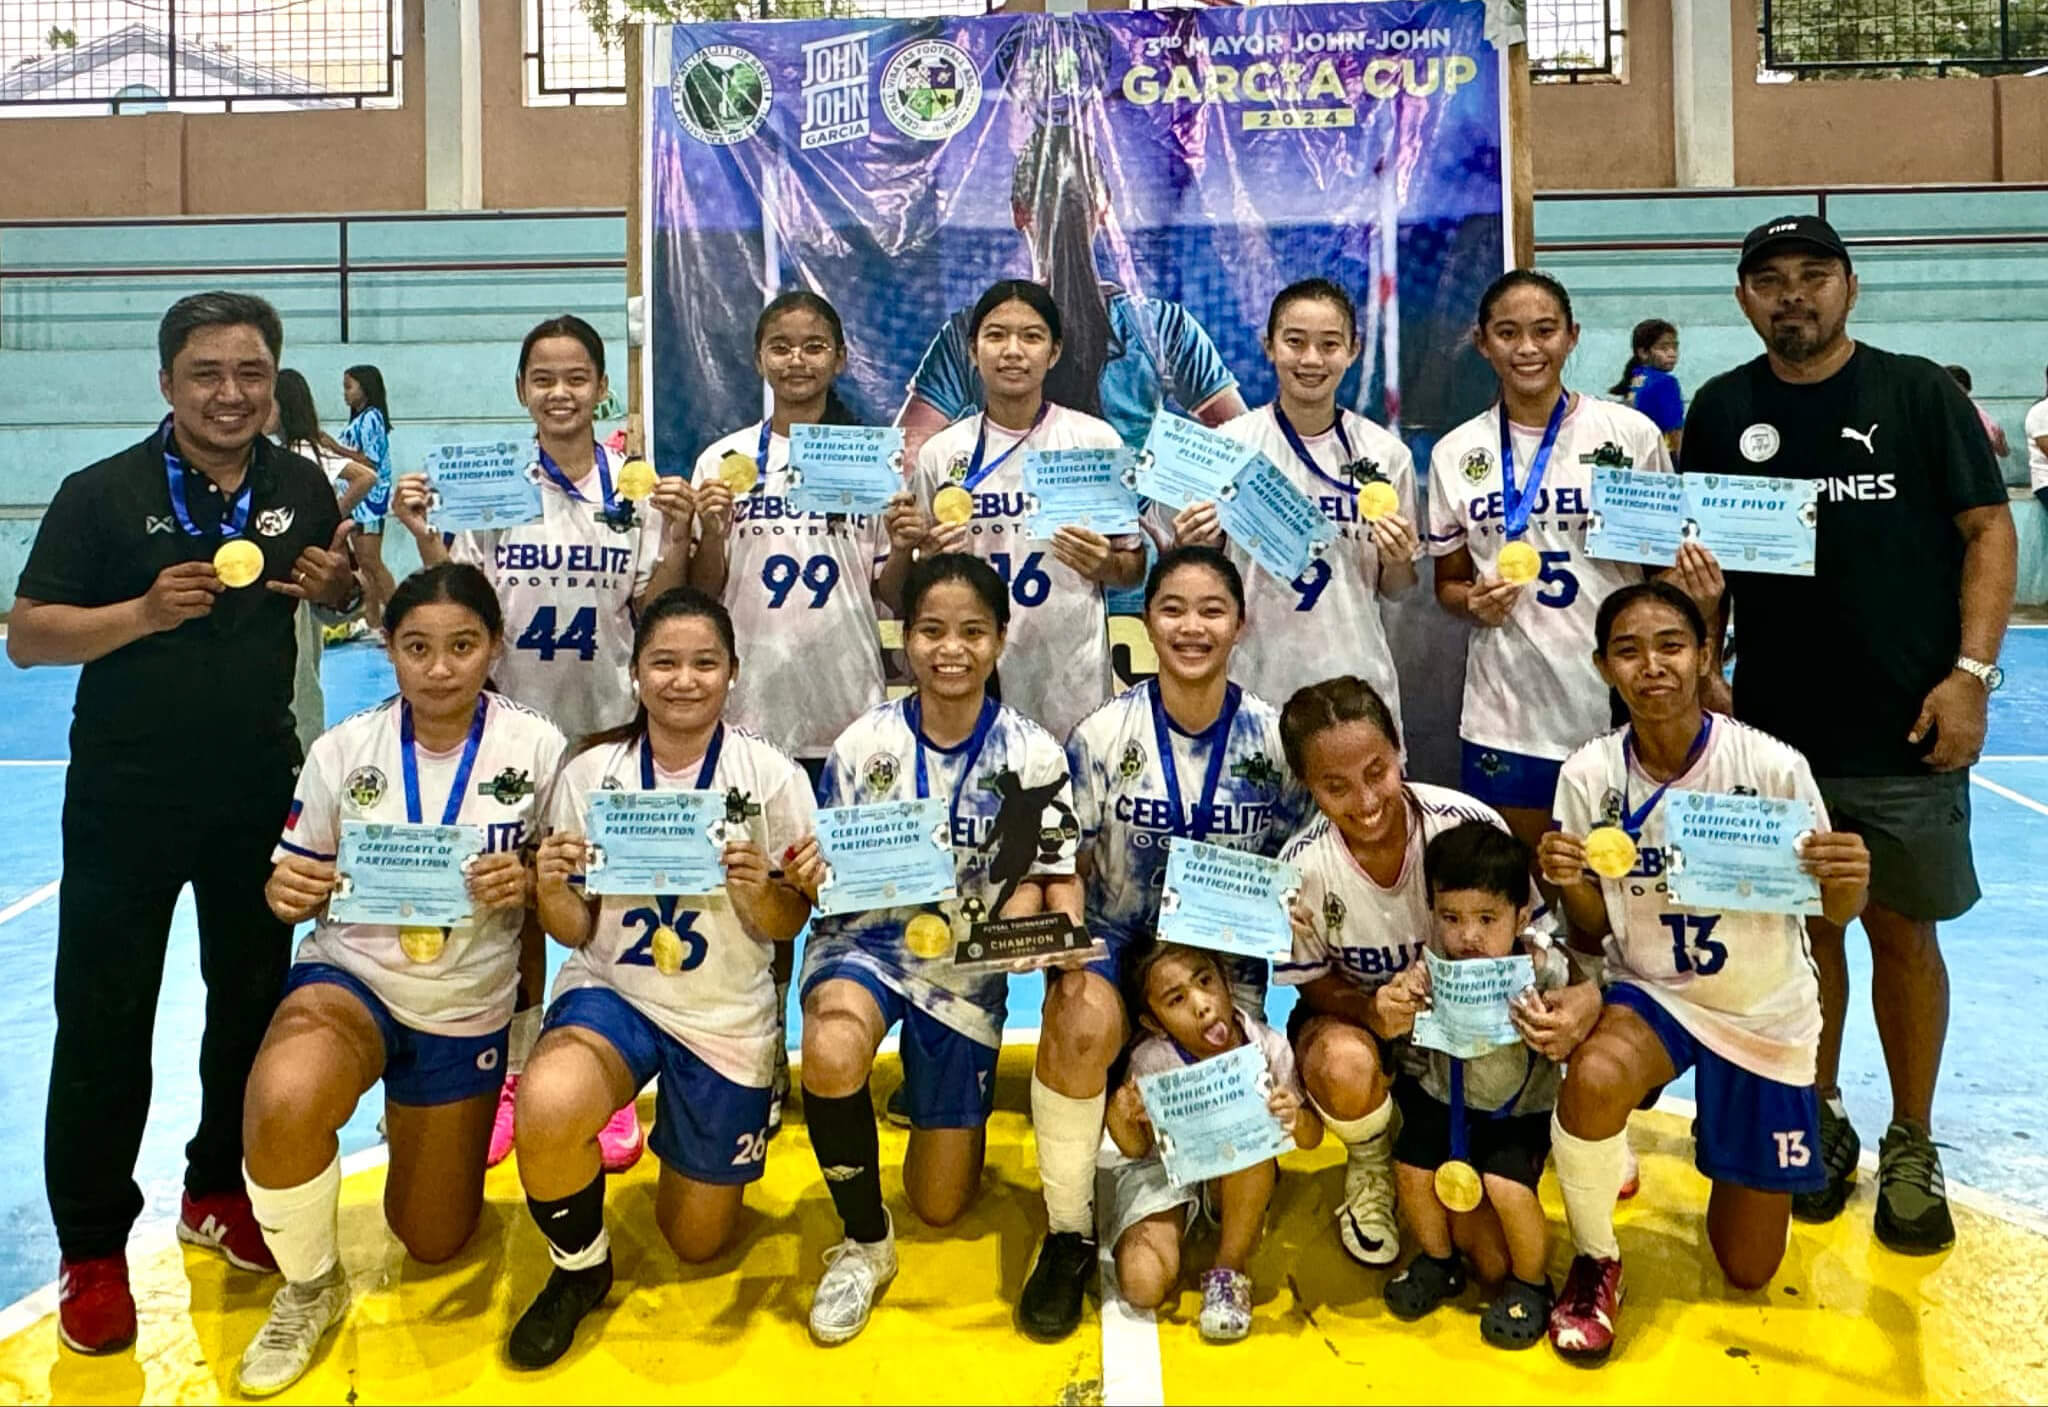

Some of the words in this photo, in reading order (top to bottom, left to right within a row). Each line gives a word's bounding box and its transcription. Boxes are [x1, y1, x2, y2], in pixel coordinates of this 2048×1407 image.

[1188, 33, 1284, 56] MAYOR
[1294, 28, 1451, 54] JOHN-JOHN
[801, 40, 869, 85] JOHN
[1122, 61, 1346, 106] GARCIA
[1363, 56, 1478, 99] CUP
[801, 86, 869, 130] JOHN
[1258, 111, 1339, 127] 2024
[805, 124, 865, 146] GARCIA
[803, 441, 865, 451] CERTIFICATE
[867, 443, 880, 452] OF
[439, 457, 500, 470] CERTIFICATE
[502, 457, 515, 468] OF
[802, 452, 879, 464] PARTICIPATION
[1036, 464, 1094, 475] CERTIFICATE
[1097, 463, 1112, 473] OF
[438, 469, 515, 482] PARTICIPATION
[1036, 475, 1112, 486] PARTICIPATION
[1469, 487, 1550, 522] CEU
[1605, 485, 1667, 501] CERTIFICATE
[1668, 492, 1682, 502] OF
[1701, 496, 1737, 511] BEST
[1741, 497, 1788, 512] PIVOT
[972, 491, 1025, 519] EBU
[1604, 498, 1680, 514] PARTICIPATION
[494, 543, 563, 571] CEBU
[568, 544, 633, 575] ELITE
[761, 553, 841, 609] 99
[989, 551, 1052, 608] 16
[1290, 558, 1333, 612] 9
[1535, 550, 1580, 609] 5
[515, 605, 600, 662] 44
[605, 812, 680, 823] CERTIFICATE
[682, 813, 696, 823] OF
[1682, 813, 1762, 830] CERTIFICATE
[1765, 820, 1783, 831] OF
[604, 825, 696, 837] PARTICIPATION
[831, 822, 904, 839] CERTIFICATE
[906, 820, 920, 831] OF
[1682, 827, 1782, 846] PARTICIPATION
[358, 842, 435, 854] CERTIFICATE
[437, 846, 453, 855] OF
[831, 833, 920, 852] PARTICIPATION
[355, 855, 451, 868] PARTICIPATION
[1185, 859, 1256, 884] CERTIFICATE
[1258, 875, 1273, 887] OF
[1182, 872, 1270, 899] PARTICIPATION
[615, 906, 709, 971] 26
[990, 933, 1055, 951] CHAMPION
[1658, 913, 1729, 976] 13
[1163, 1088, 1246, 1119] PARTICIPATION
[731, 1127, 766, 1166] 26
[1772, 1130, 1812, 1168] 13
